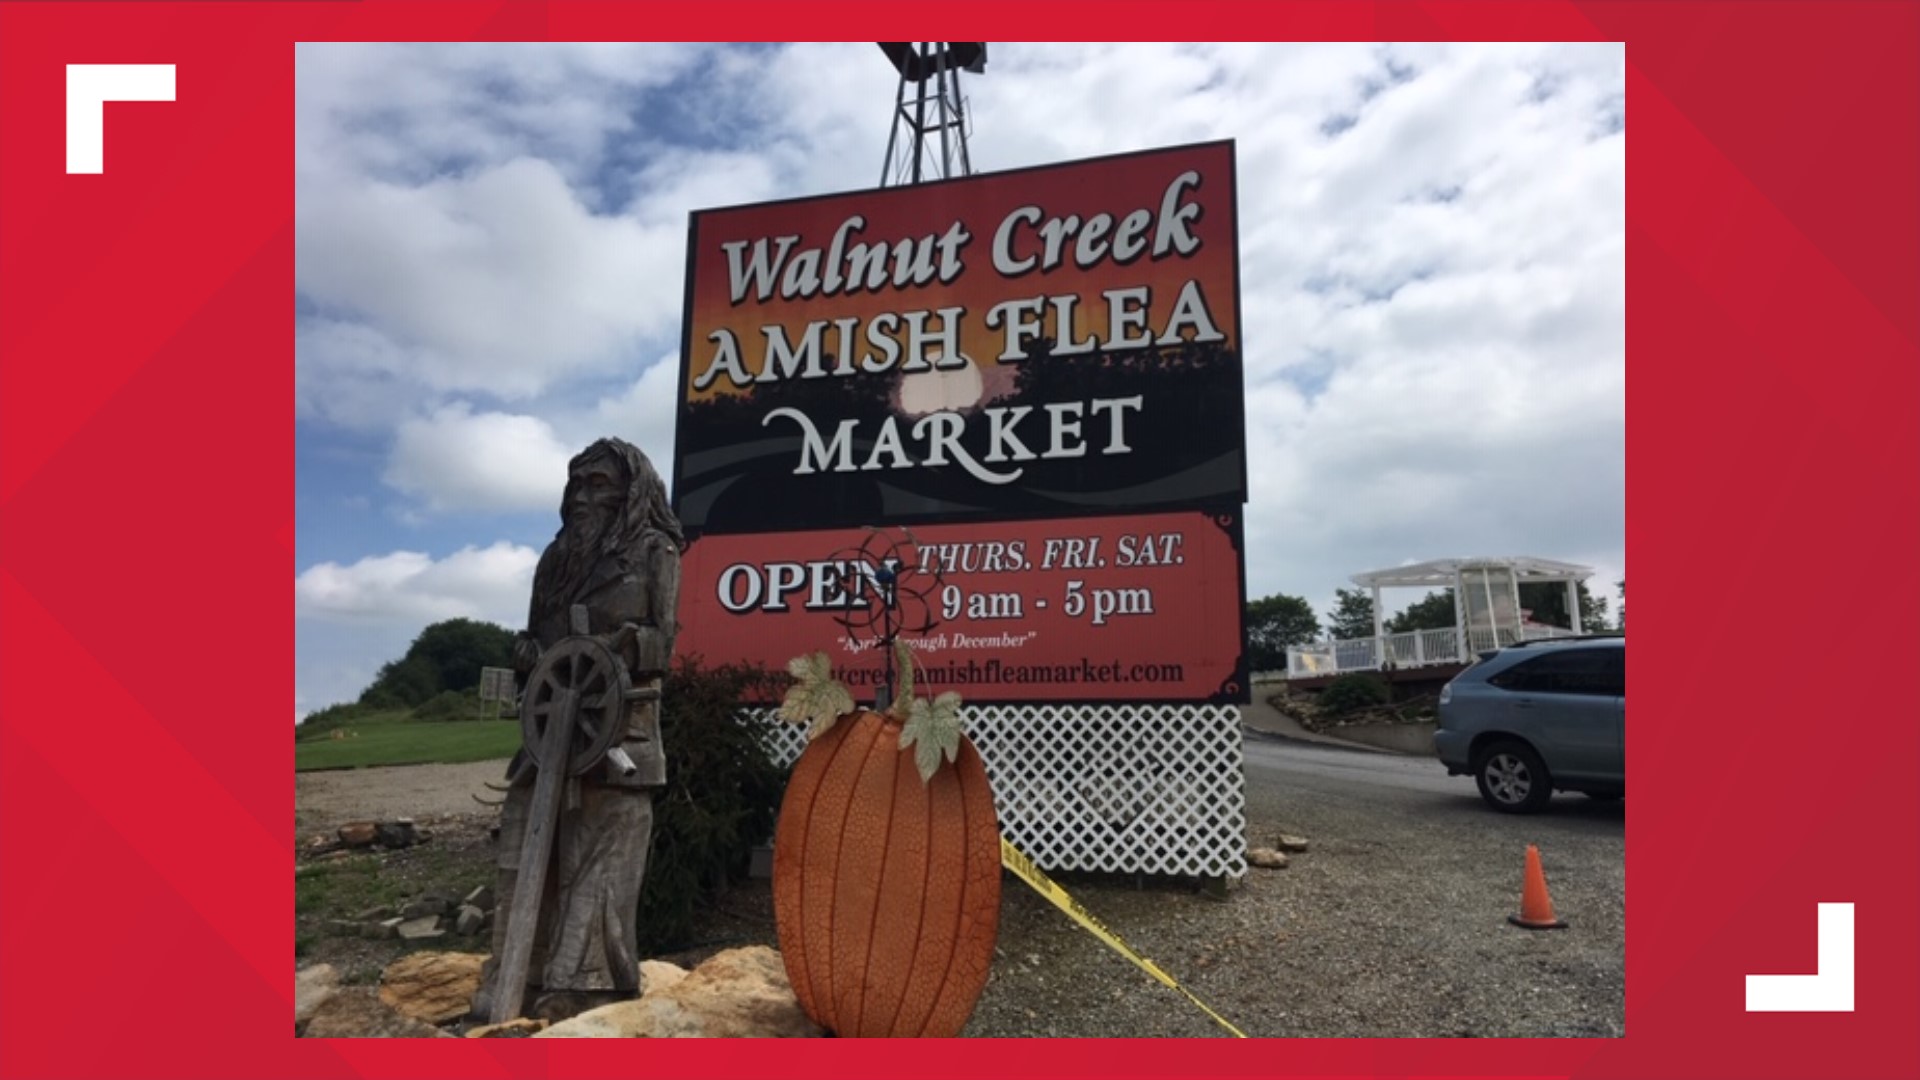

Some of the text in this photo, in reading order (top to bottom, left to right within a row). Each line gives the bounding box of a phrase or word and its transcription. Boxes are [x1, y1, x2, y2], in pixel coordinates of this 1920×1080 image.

[721, 170, 1201, 304] Walnut Creek
[694, 279, 1224, 389] AMISH FLEA
[762, 395, 1143, 484] MARKET
[718, 558, 899, 612] OPEN
[918, 533, 1184, 574] THURS. FRI. SAT.
